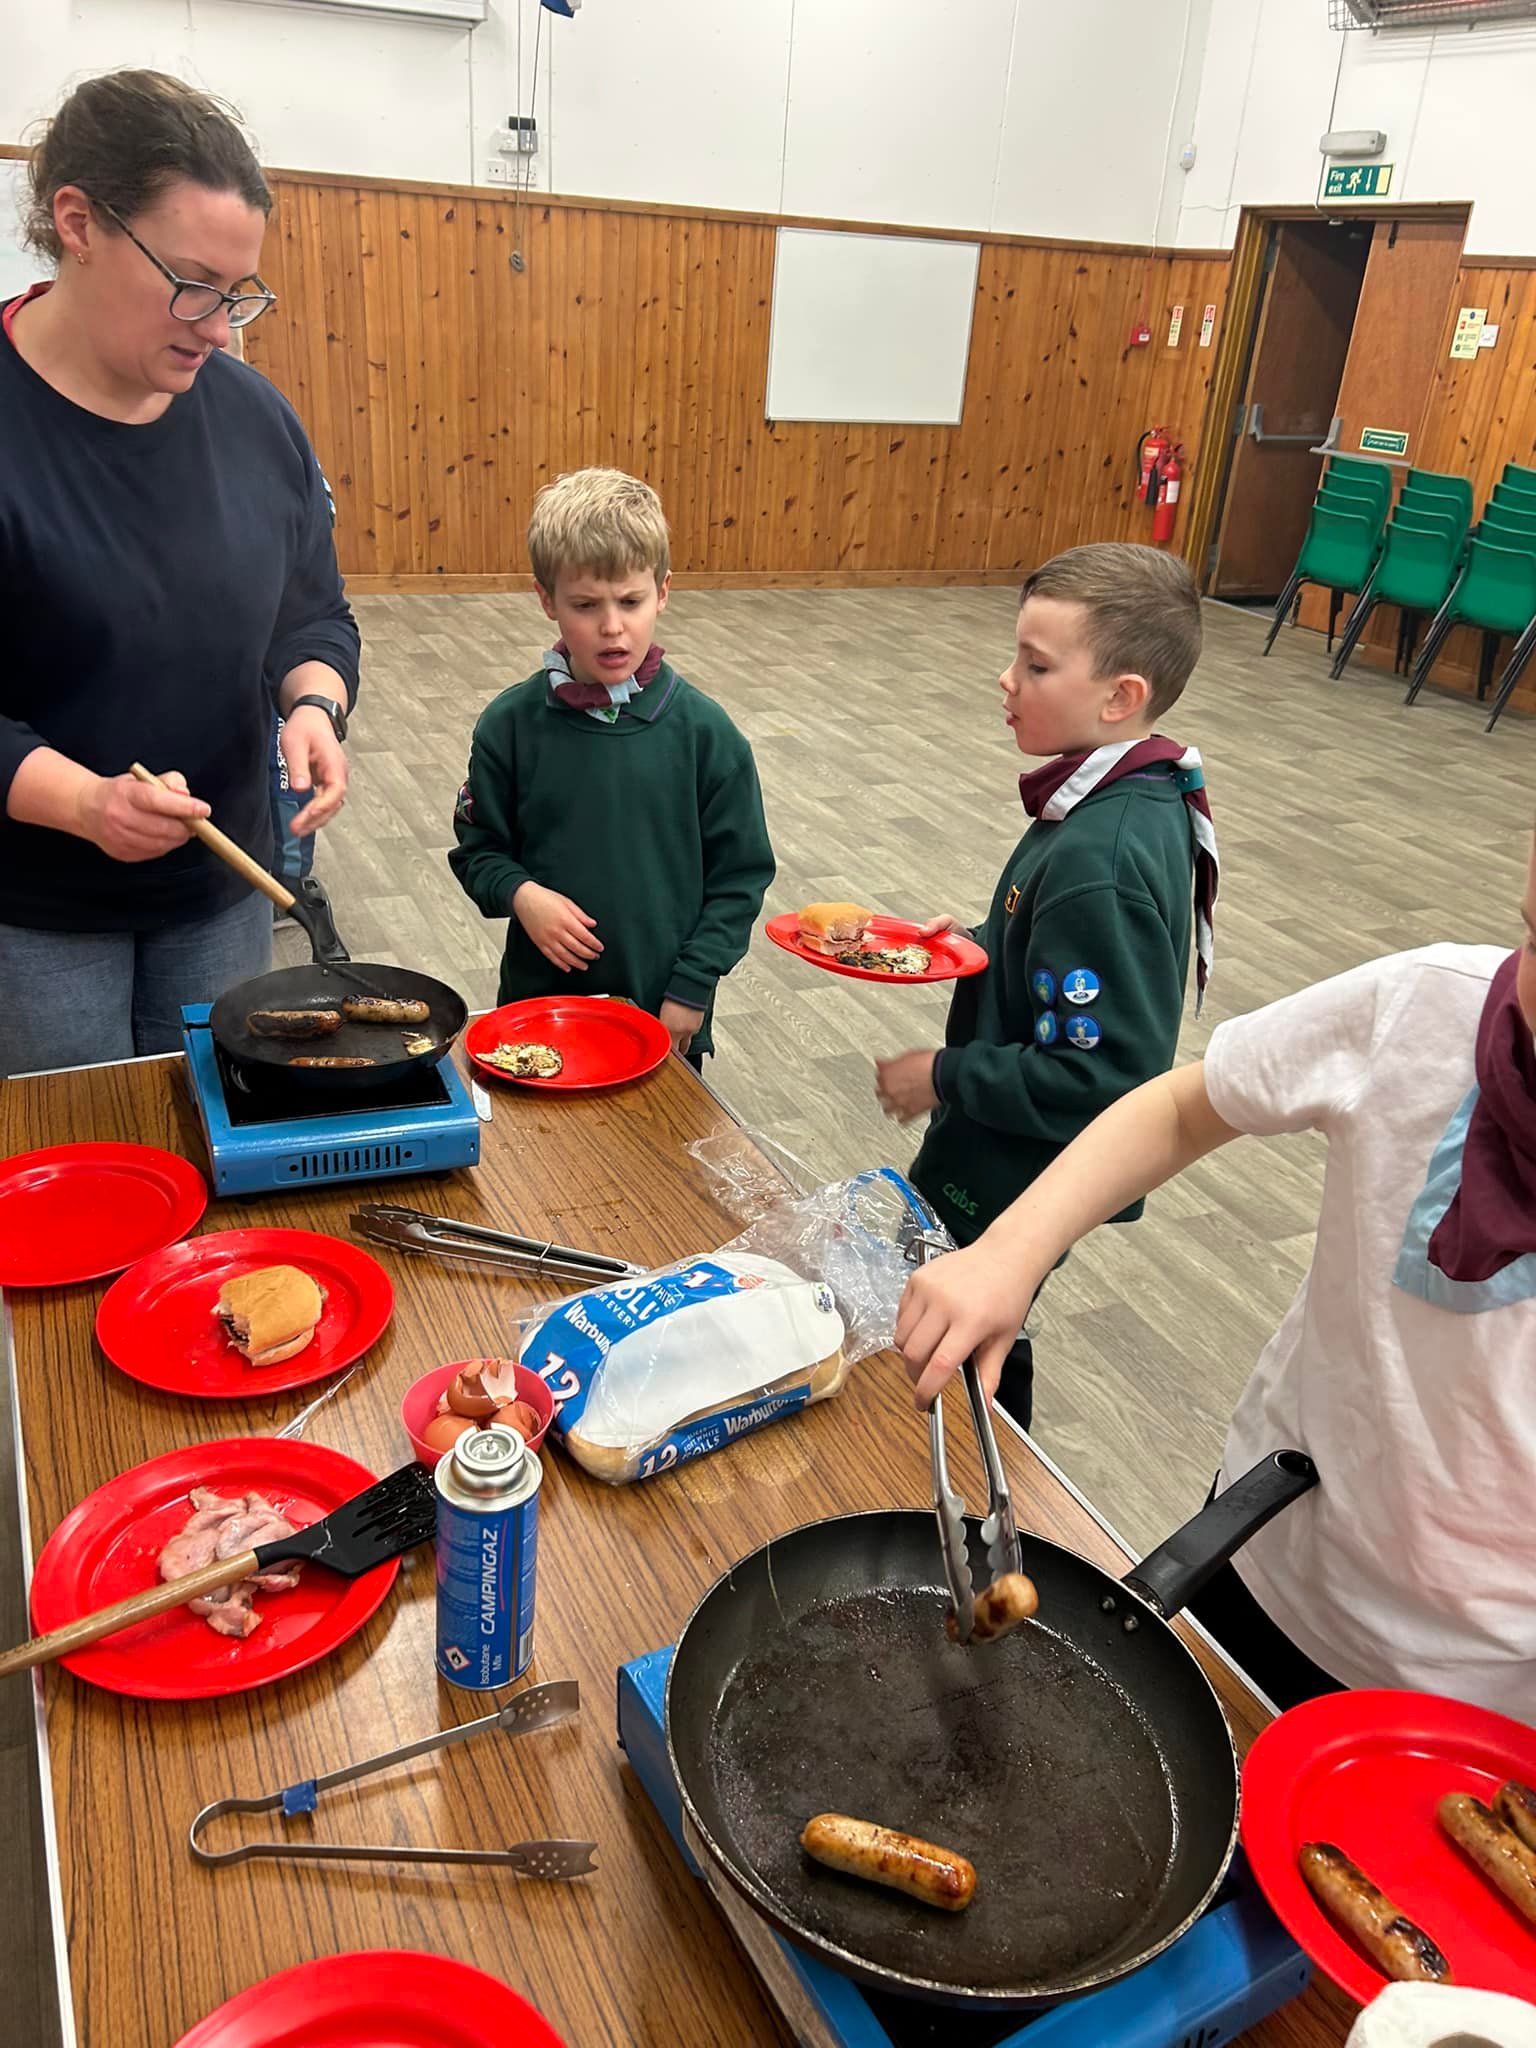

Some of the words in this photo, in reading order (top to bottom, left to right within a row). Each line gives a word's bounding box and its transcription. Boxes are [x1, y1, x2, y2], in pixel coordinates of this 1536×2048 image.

[943, 1183, 979, 1216] cubs
[648, 1283, 677, 1308] WHITE
[607, 1300, 637, 1329] EVERY
[695, 1427, 720, 1443] WHITE
[640, 1444, 679, 1479] 12
[480, 1528, 498, 1635] CAMPINGAZ
[480, 1644, 490, 1685] Isobutane
